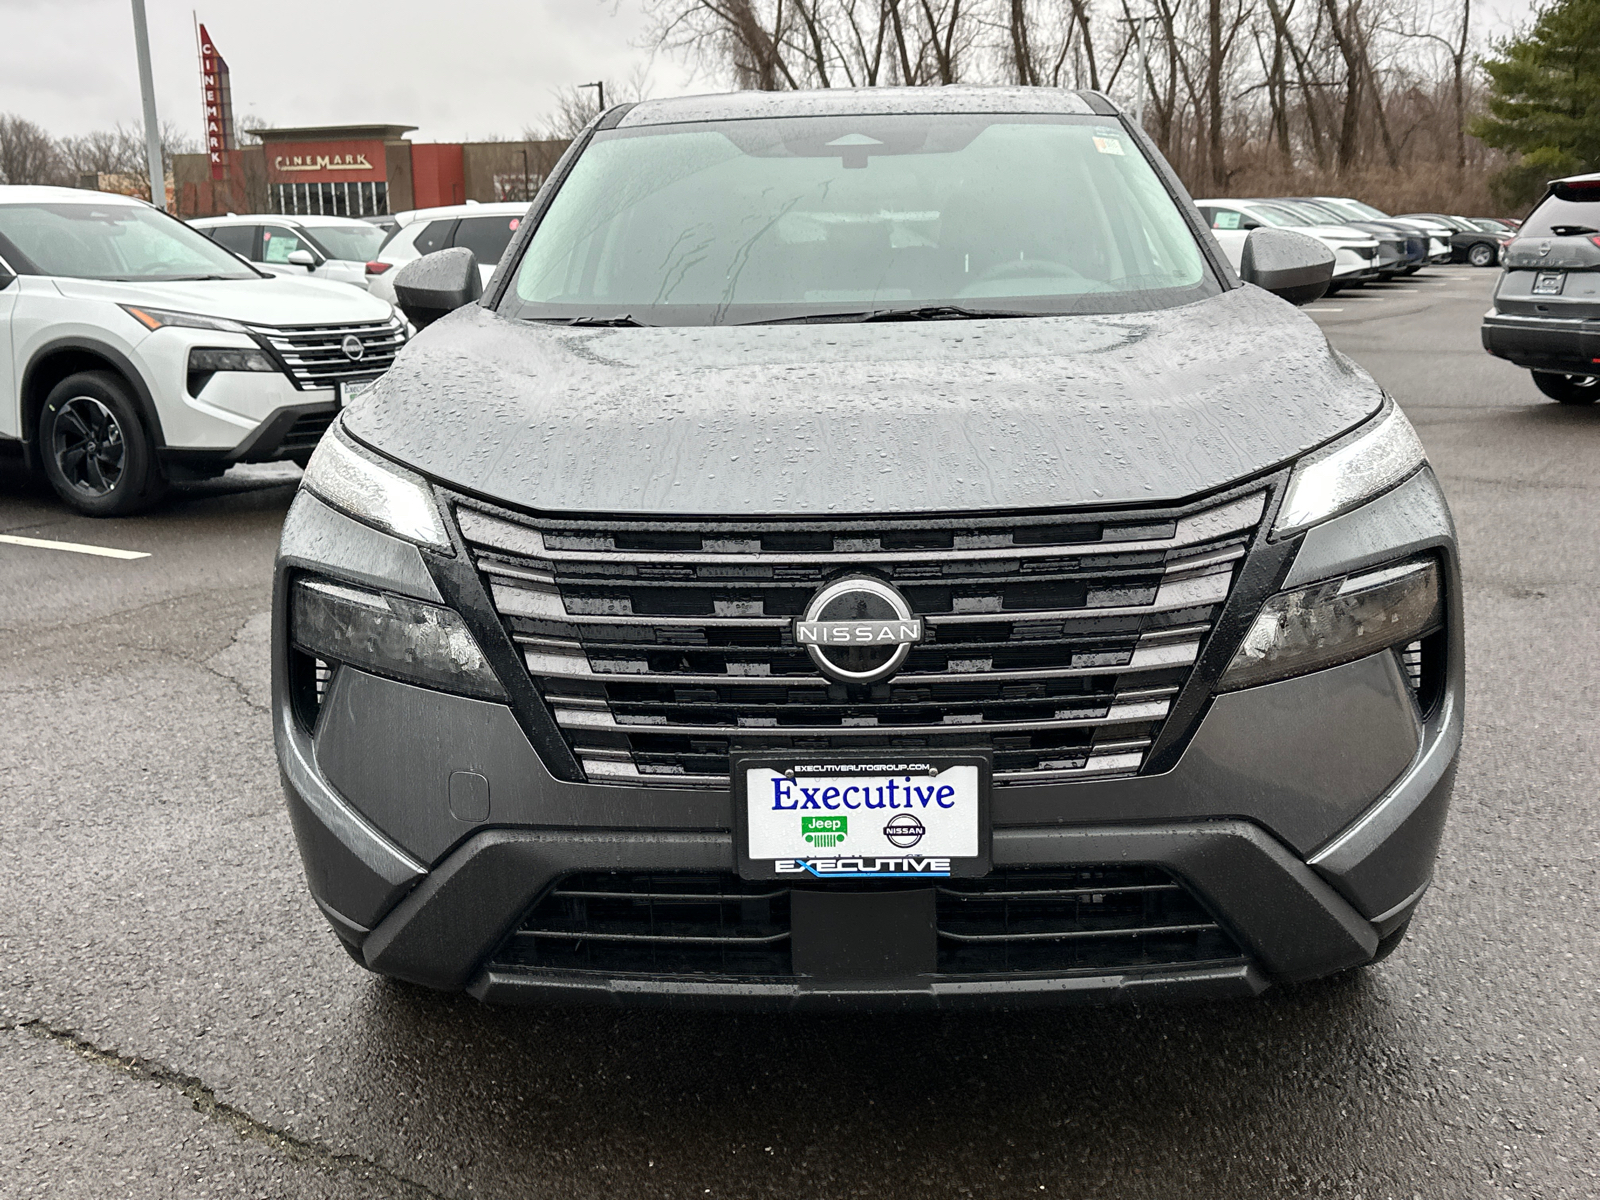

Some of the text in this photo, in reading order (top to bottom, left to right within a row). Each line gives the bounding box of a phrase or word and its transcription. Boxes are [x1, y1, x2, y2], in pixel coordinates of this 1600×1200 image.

[202, 43, 221, 163] CINEMARK
[275, 154, 373, 171] CINEMARK
[799, 624, 918, 642] NISSAN
[794, 764, 930, 772] EXECUTIVEAUTOGROUP.COM
[771, 776, 955, 810] Executive
[808, 818, 841, 831] Jeep
[775, 858, 951, 874] EXECUTIVE
